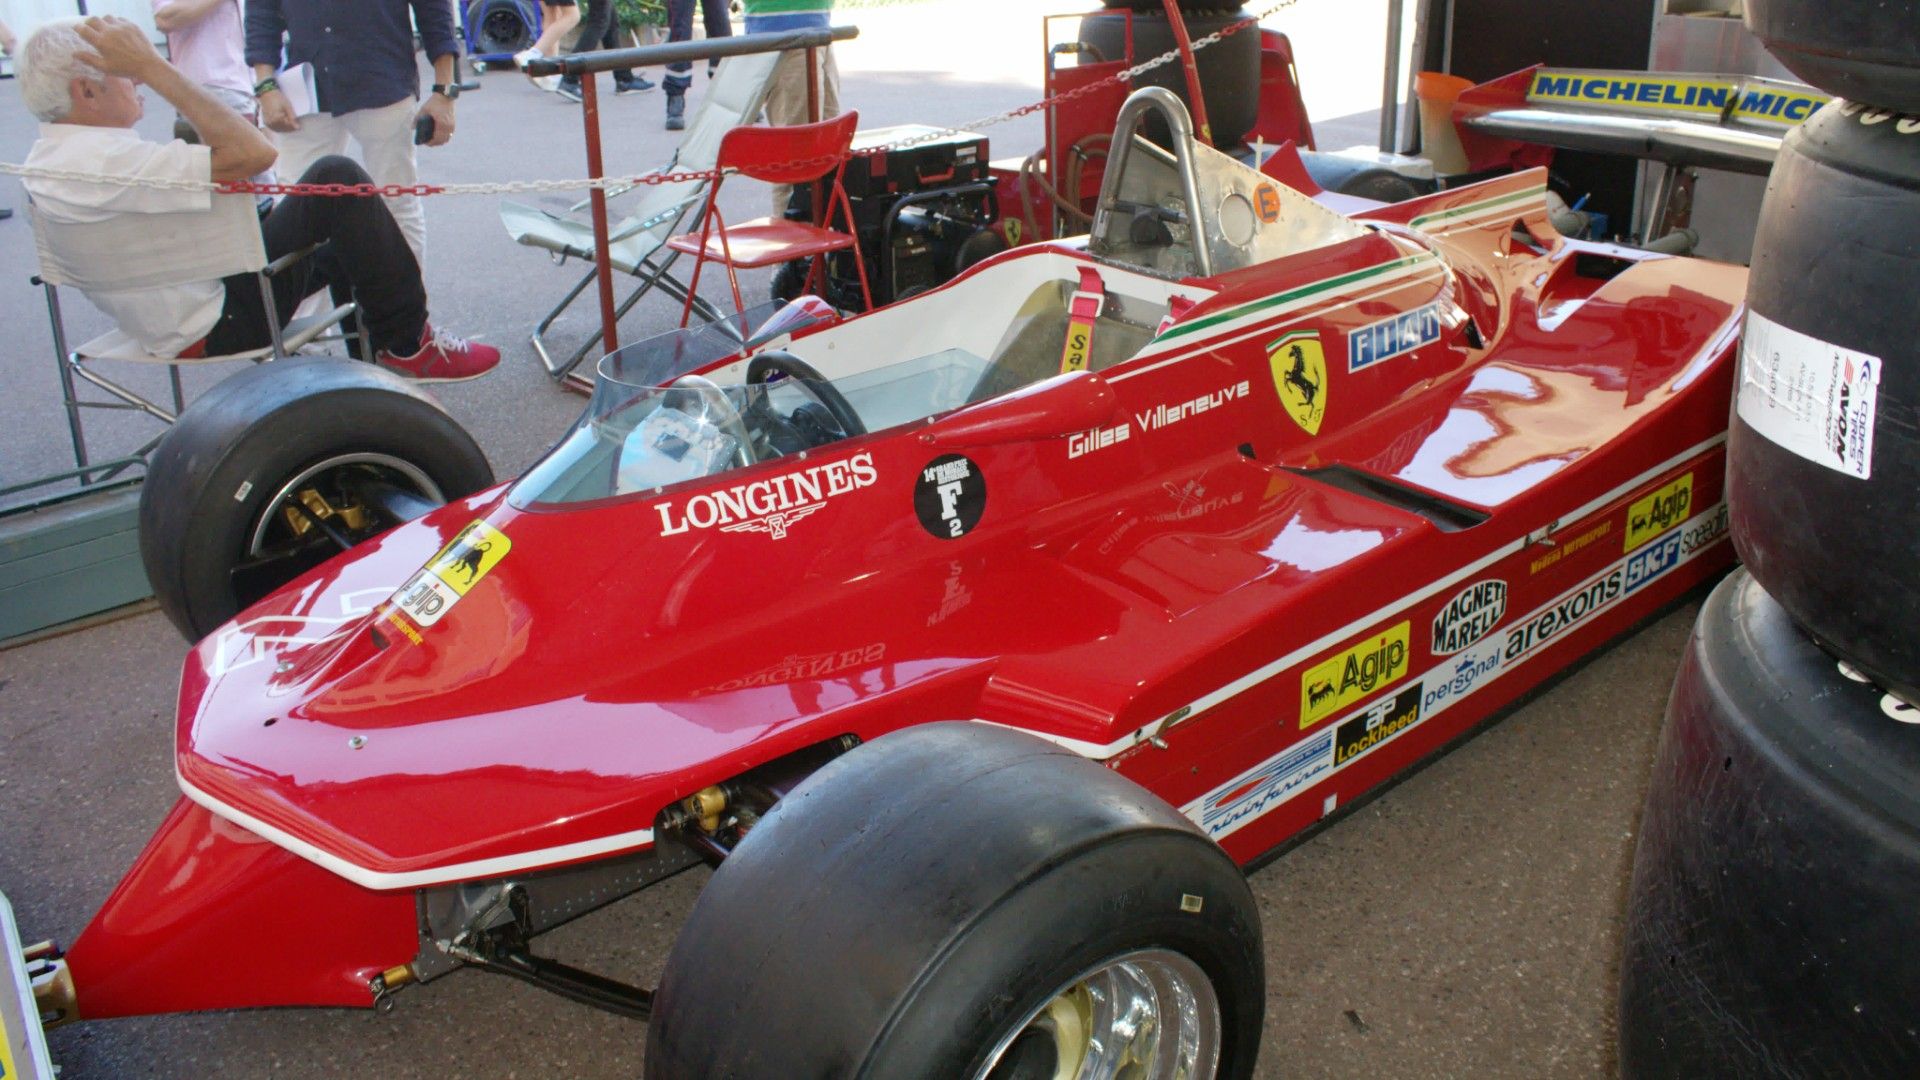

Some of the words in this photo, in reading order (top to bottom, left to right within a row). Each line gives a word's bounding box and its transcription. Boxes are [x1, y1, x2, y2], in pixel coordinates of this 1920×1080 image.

[1535, 76, 1728, 108] MICHELIN
[1258, 187, 1277, 220] E
[1069, 334, 1087, 371] Sa
[1356, 307, 1437, 364] FIAT
[1068, 422, 1130, 459] Gilles
[1135, 380, 1250, 433] Villeneuve
[1836, 382, 1851, 465] AVON
[1850, 410, 1859, 460] TIRES
[1856, 400, 1868, 475] COOPER
[653, 452, 878, 537] LONGINES
[937, 480, 962, 521] F
[1648, 485, 1689, 529] Agip
[949, 518, 964, 537] 2
[399, 576, 445, 616] gip
[1434, 582, 1506, 636] MAGNETI
[1505, 570, 1622, 660] arexons
[1626, 535, 1681, 587] SKF
[1434, 599, 1506, 652] MARELLI
[1339, 637, 1405, 696] Agip
[1424, 647, 1500, 712] personal
[1337, 704, 1418, 764] Lockheed
